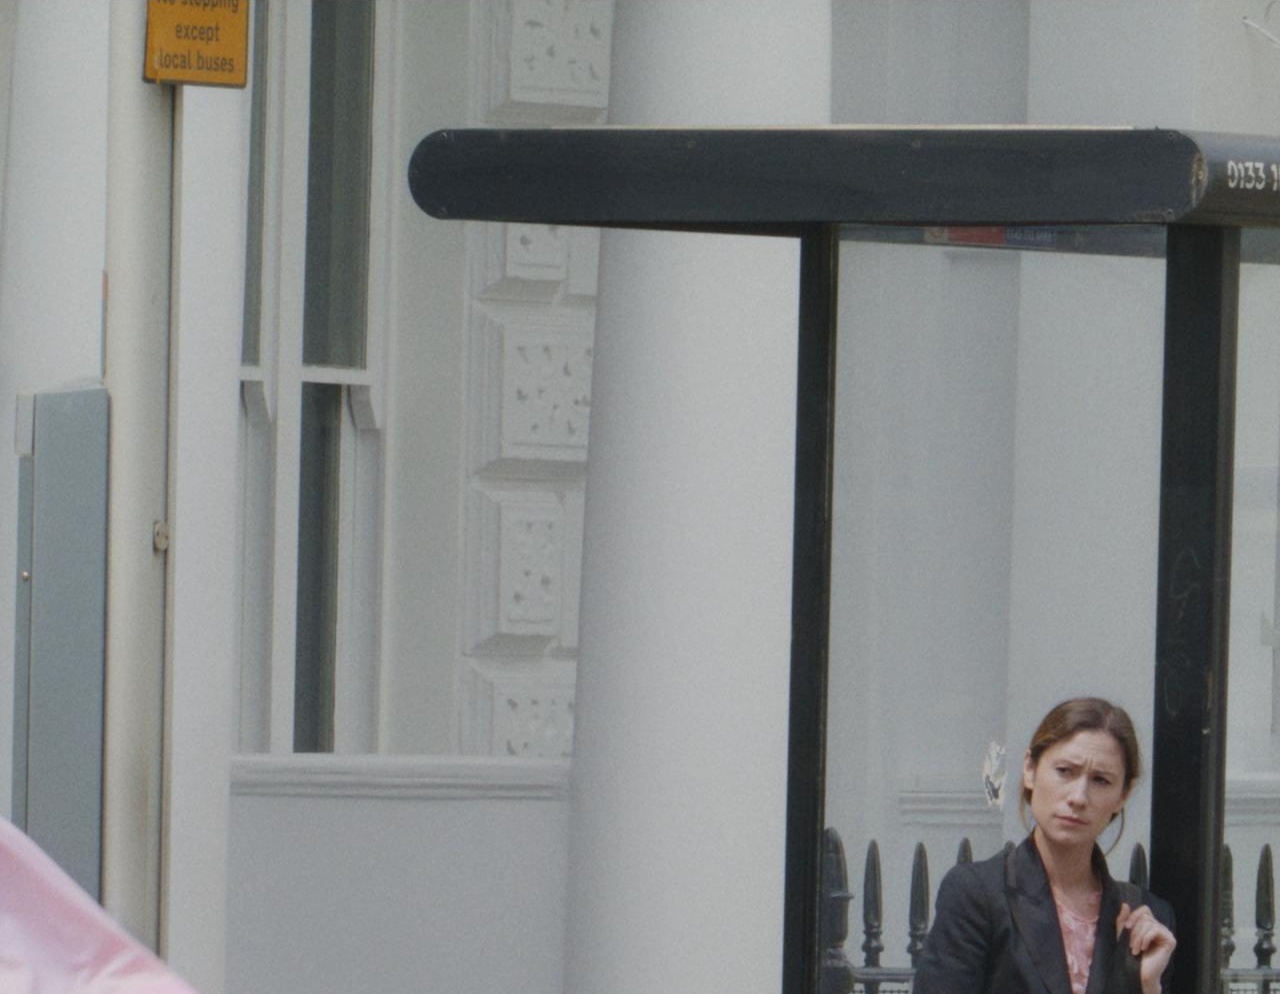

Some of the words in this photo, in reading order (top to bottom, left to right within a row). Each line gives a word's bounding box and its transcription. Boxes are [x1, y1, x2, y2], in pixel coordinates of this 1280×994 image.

[180, 0, 240, 13] ppng
[175, 22, 220, 44] except
[158, 48, 192, 70] local
[196, 50, 235, 73] buses
[1227, 160, 1266, 190] 0133
